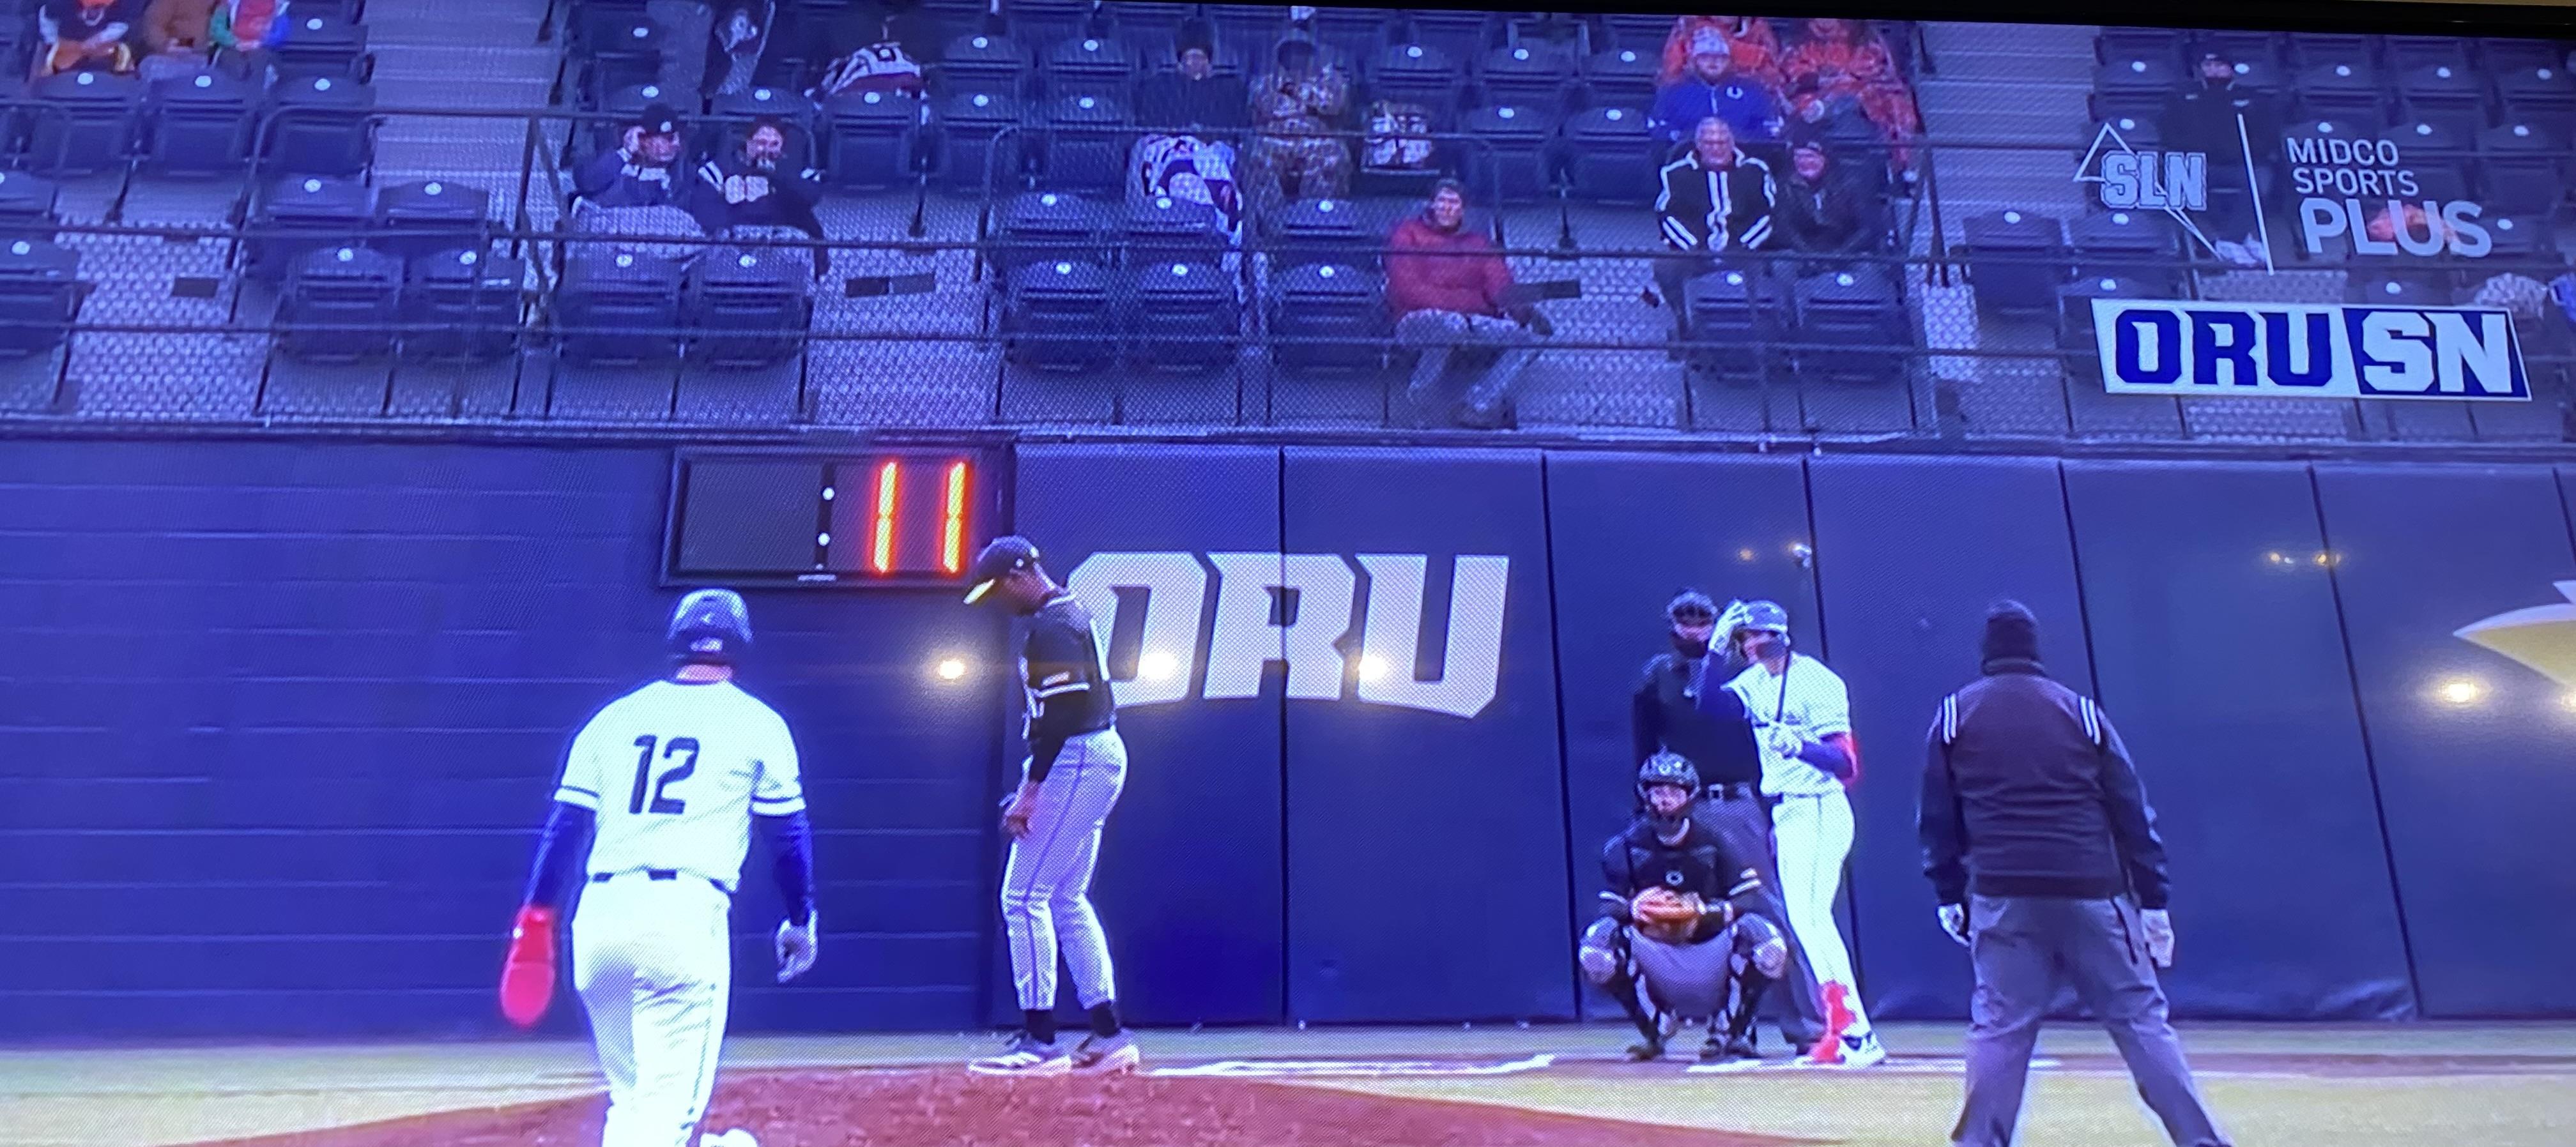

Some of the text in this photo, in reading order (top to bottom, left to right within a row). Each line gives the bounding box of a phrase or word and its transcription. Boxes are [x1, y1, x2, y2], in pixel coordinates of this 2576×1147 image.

[2100, 151, 2207, 211] SLN
[2287, 137, 2399, 166] MIDCO
[2292, 169, 2419, 197] SPORTS
[2299, 198, 2493, 257] PLUS
[873, 460, 966, 574] 11
[1068, 551, 1510, 719] ORU
[629, 734, 700, 815] 12
